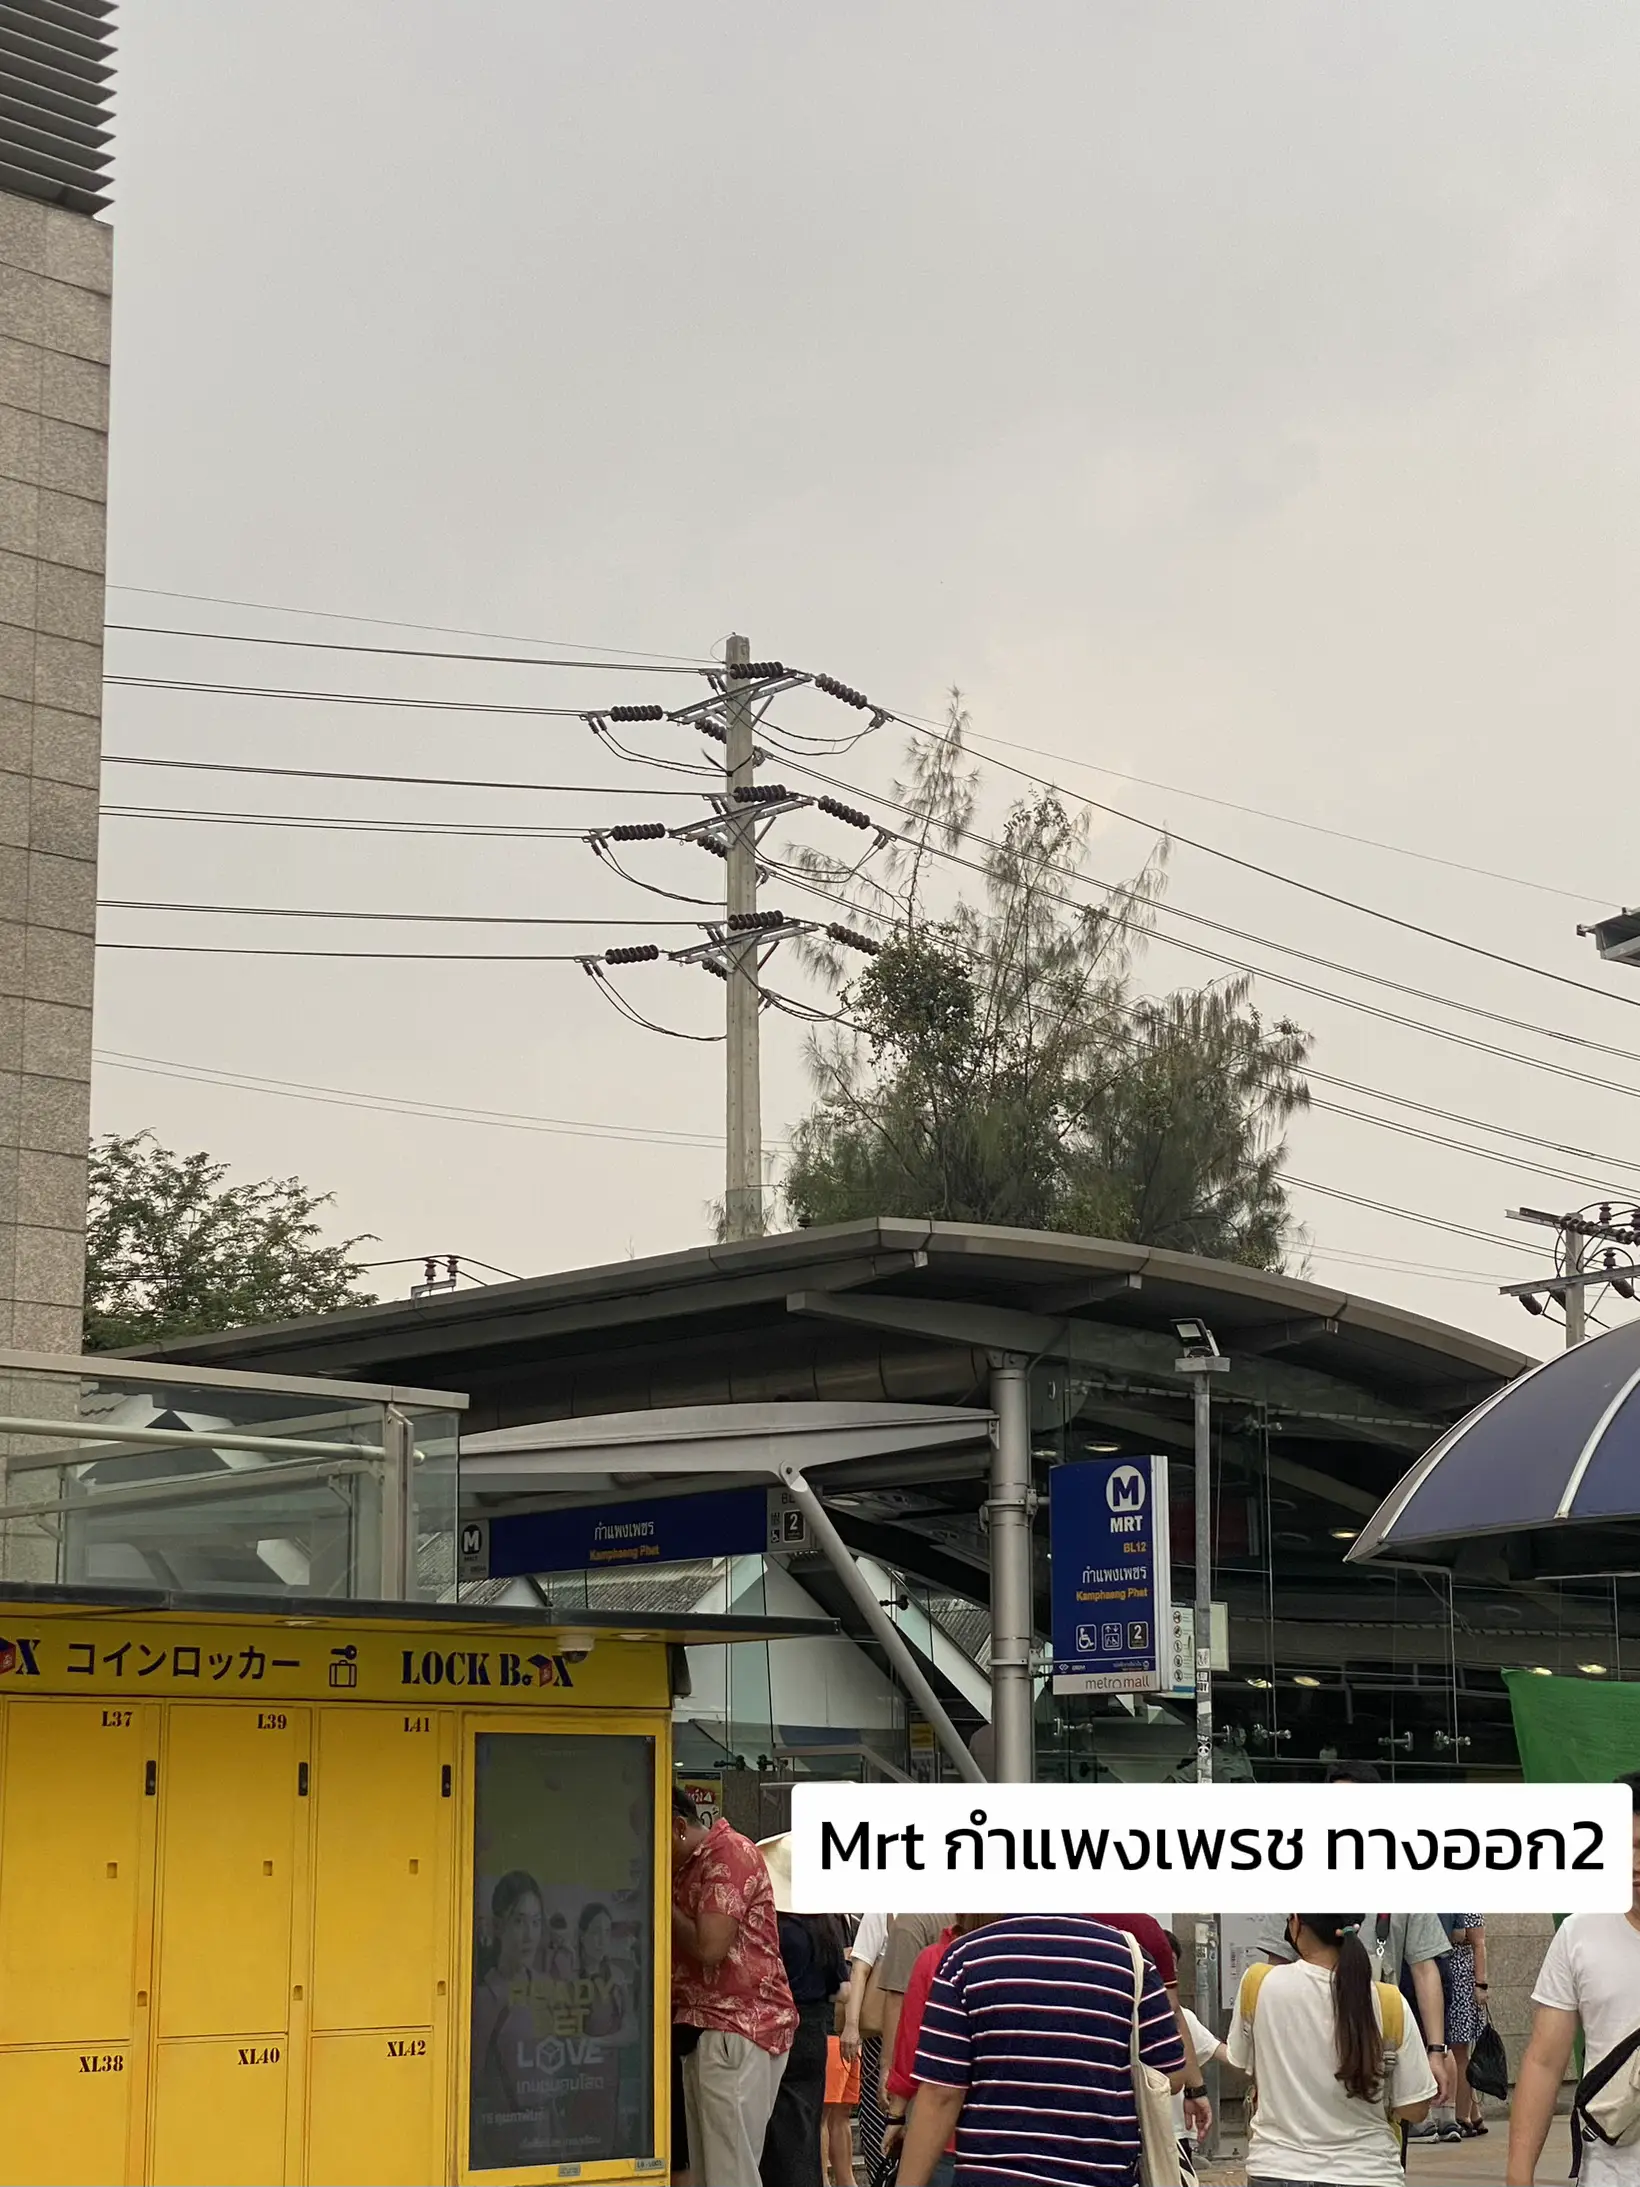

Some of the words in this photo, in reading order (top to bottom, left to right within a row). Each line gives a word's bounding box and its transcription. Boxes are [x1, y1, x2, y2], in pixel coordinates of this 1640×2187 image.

[790, 1513, 798, 1530] 2
[1110, 1515, 1143, 1533] MRT
[594, 1521, 655, 1541] กำแพงเพชร
[1123, 1541, 1147, 1553] BL12
[1082, 1565, 1147, 1583] กำแพงเพชร
[1134, 1624, 1142, 1640] 2
[67, 1641, 300, 1681] コインロッカー
[401, 1650, 492, 1686] LOCK
[102, 1711, 133, 1727] L37
[257, 1713, 287, 1730] L39
[403, 1717, 431, 1733] L41
[237, 2047, 280, 2066] XL40
[386, 2040, 426, 2057] XL42
[516, 2035, 605, 2074] LOVE
[78, 2055, 124, 2073] XL38
